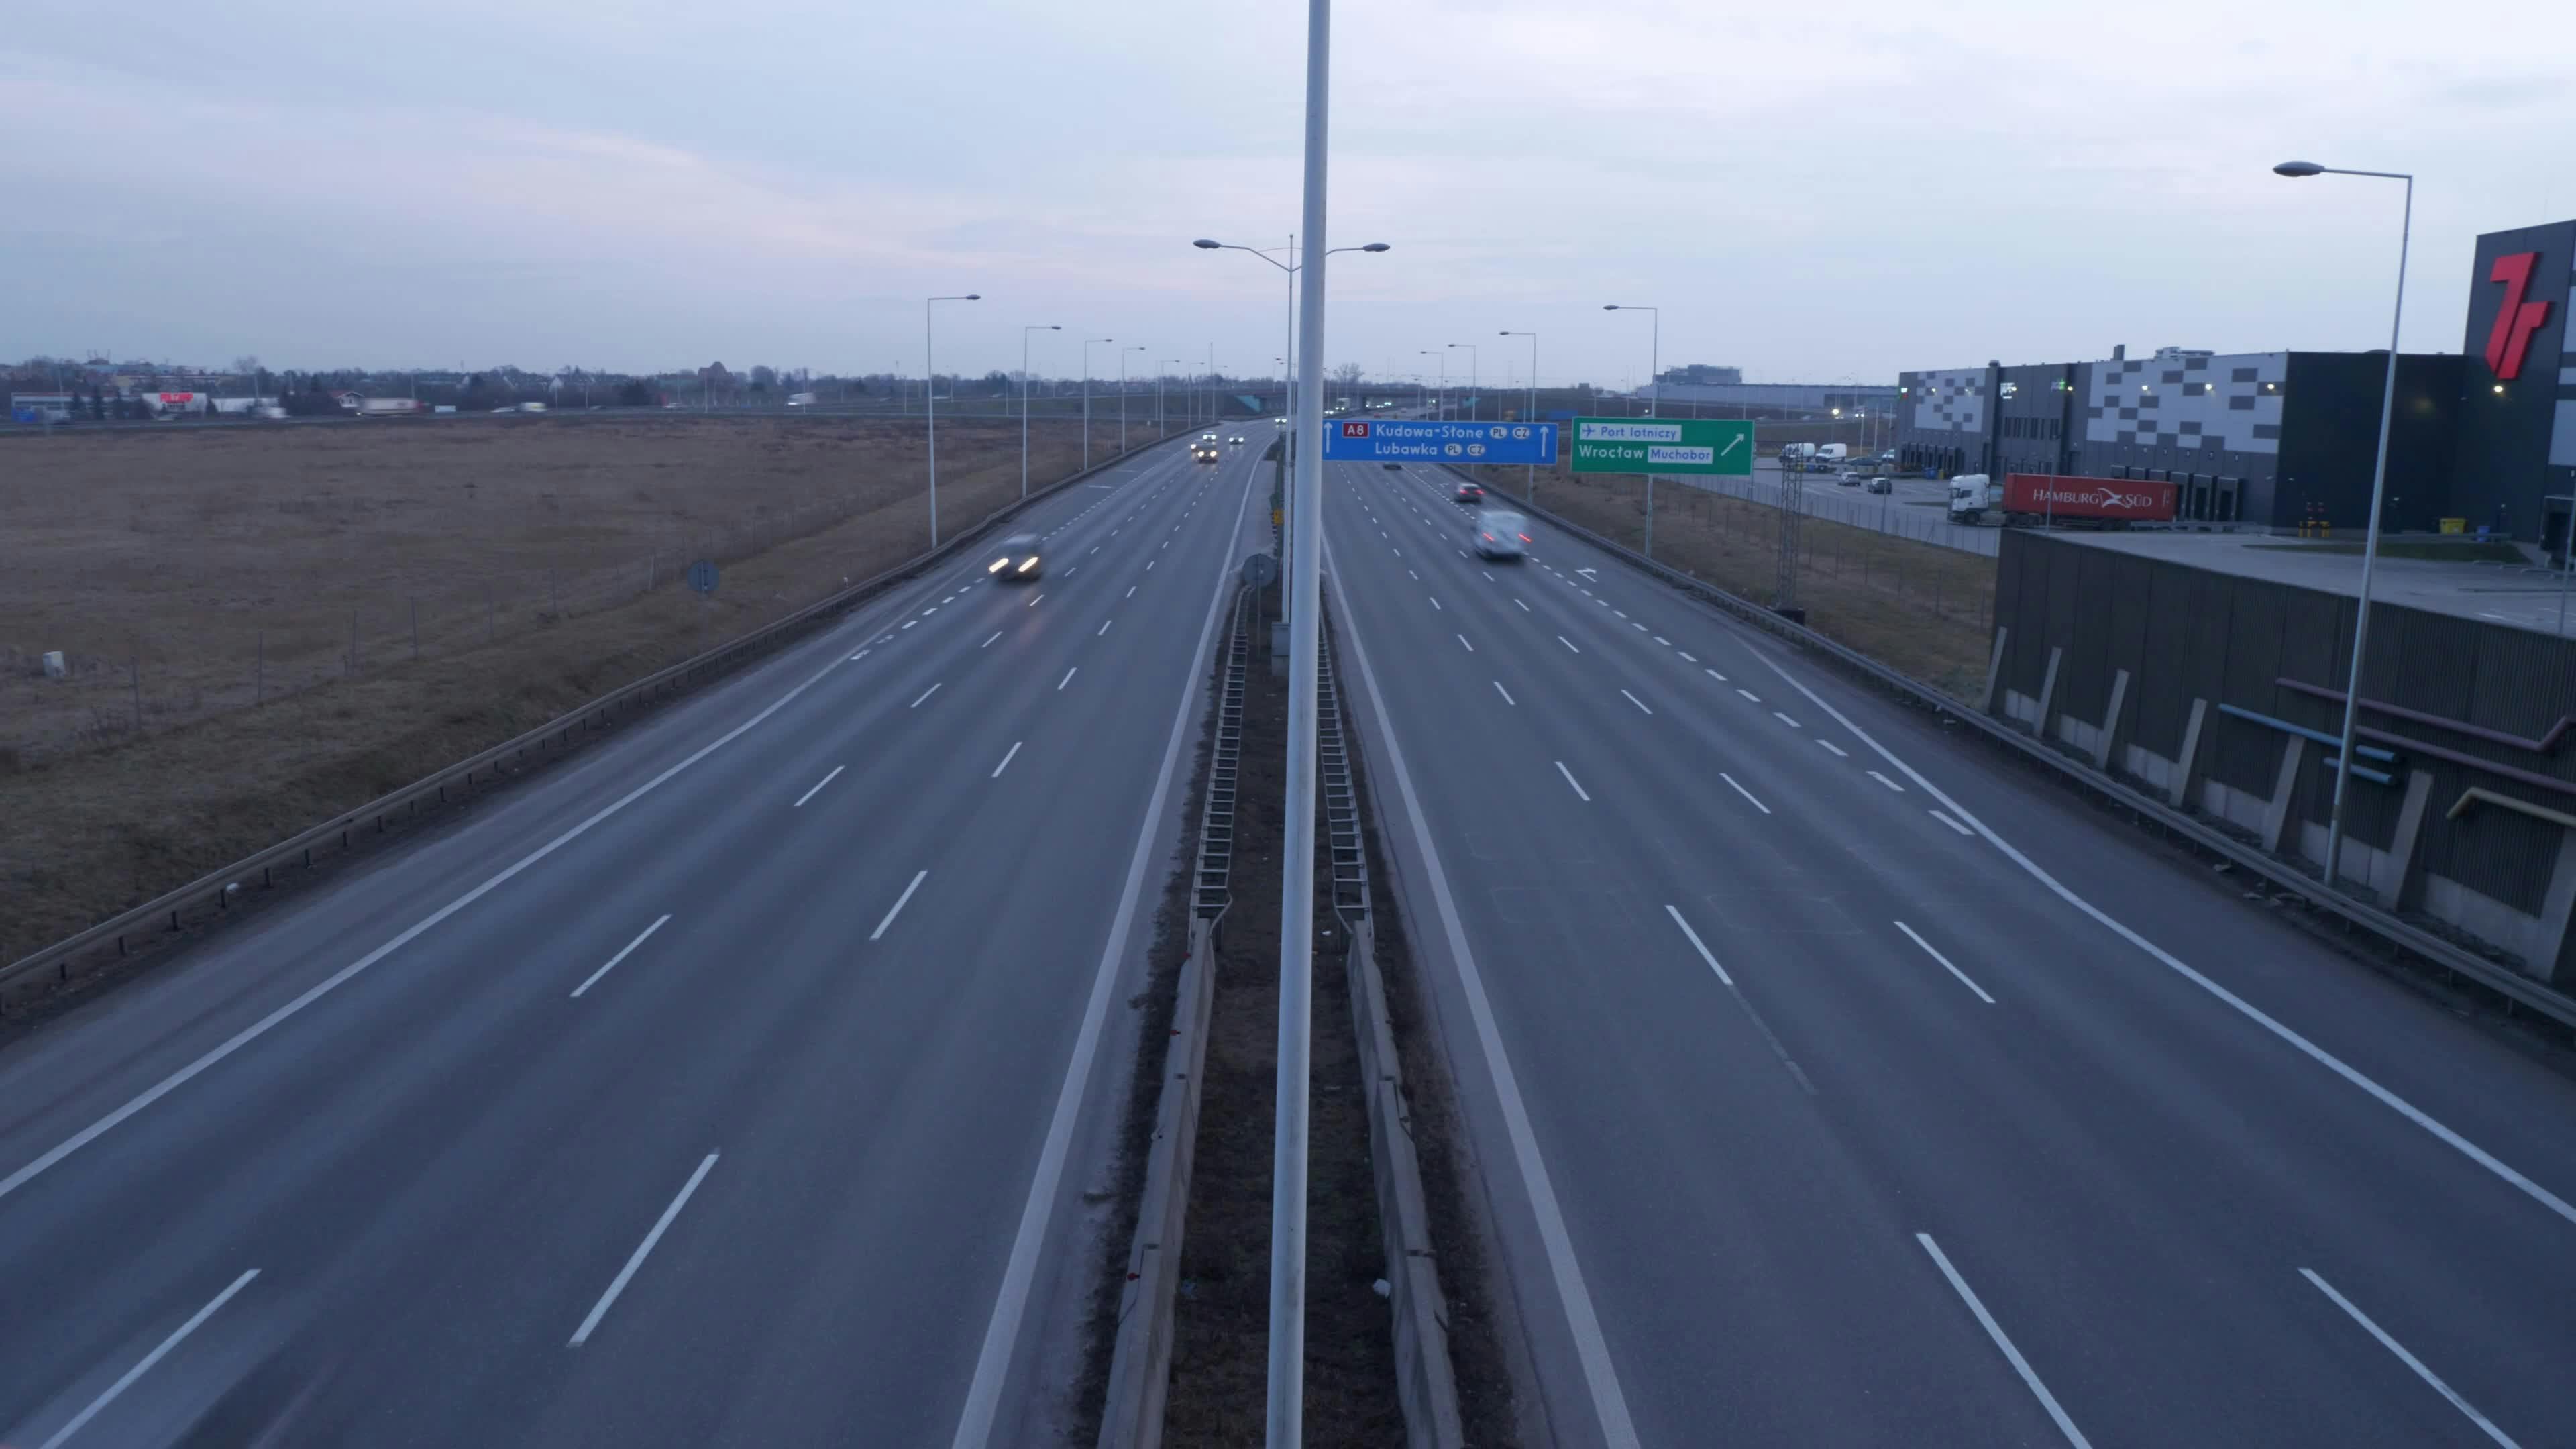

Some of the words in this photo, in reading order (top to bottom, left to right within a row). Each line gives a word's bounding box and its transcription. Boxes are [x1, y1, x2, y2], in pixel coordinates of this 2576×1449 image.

[1347, 425, 1364, 435] A8
[1376, 424, 1483, 439] Kudowa-Słone
[1492, 429, 1504, 437] PL
[1515, 429, 1527, 437] CZ
[1601, 426, 1624, 437] Port
[1631, 427, 1676, 441] lotniczy
[1375, 443, 1438, 455] Lubawka
[1448, 445, 1458, 454] PL
[1579, 445, 1644, 459] Wrocław
[2033, 488, 2099, 505] HAMBURG
[2125, 492, 2152, 508] SÜD
